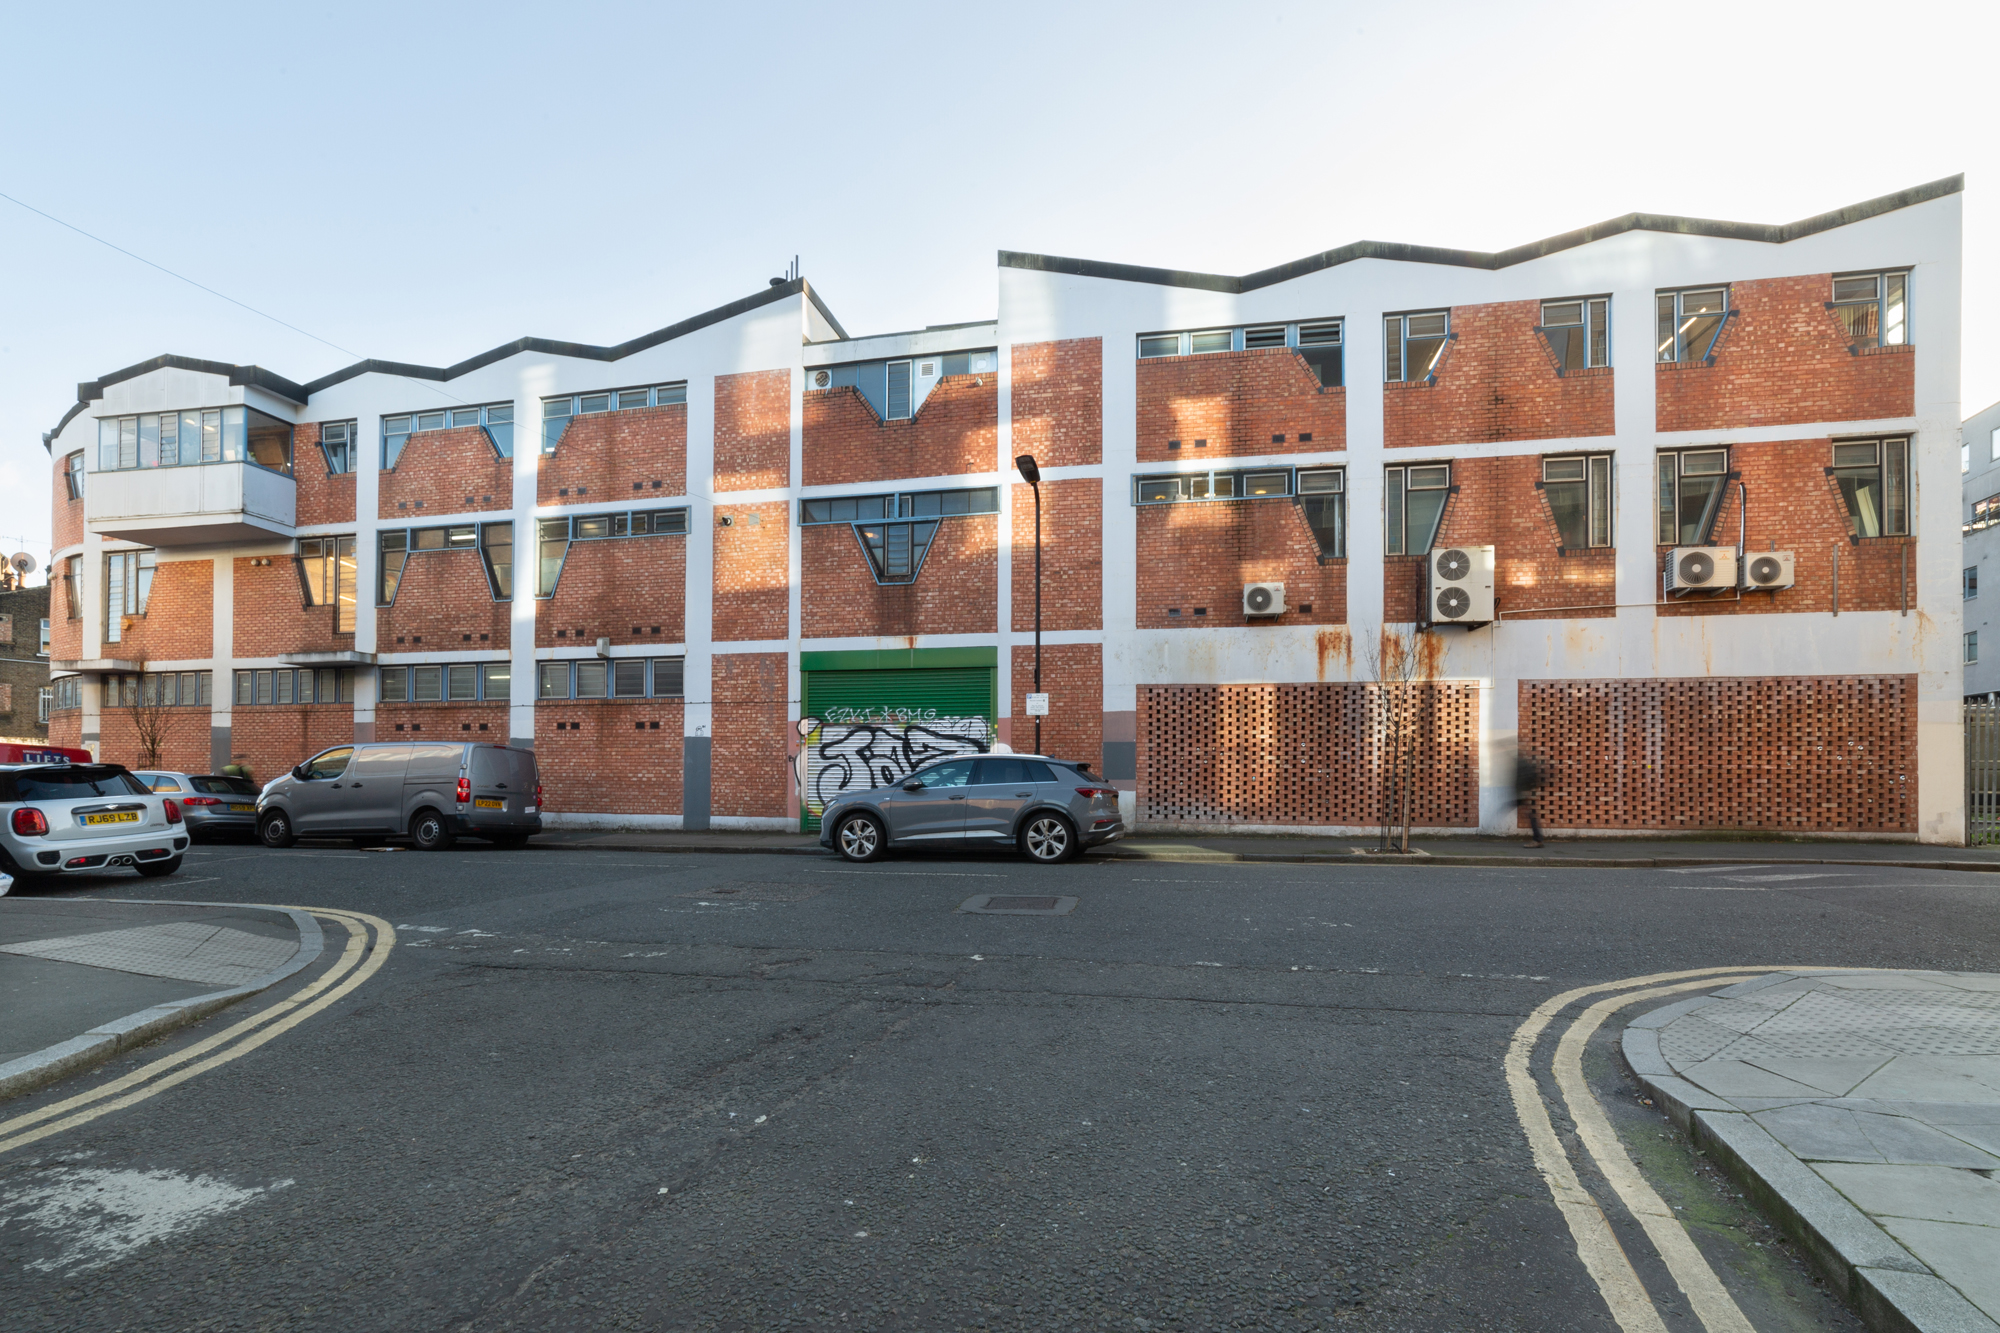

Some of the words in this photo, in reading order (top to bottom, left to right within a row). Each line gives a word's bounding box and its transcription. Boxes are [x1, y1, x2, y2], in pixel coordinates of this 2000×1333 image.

[25, 753, 71, 764] LIFTS
[87, 814, 116, 824] RJ69
[117, 812, 138, 822] LZB
